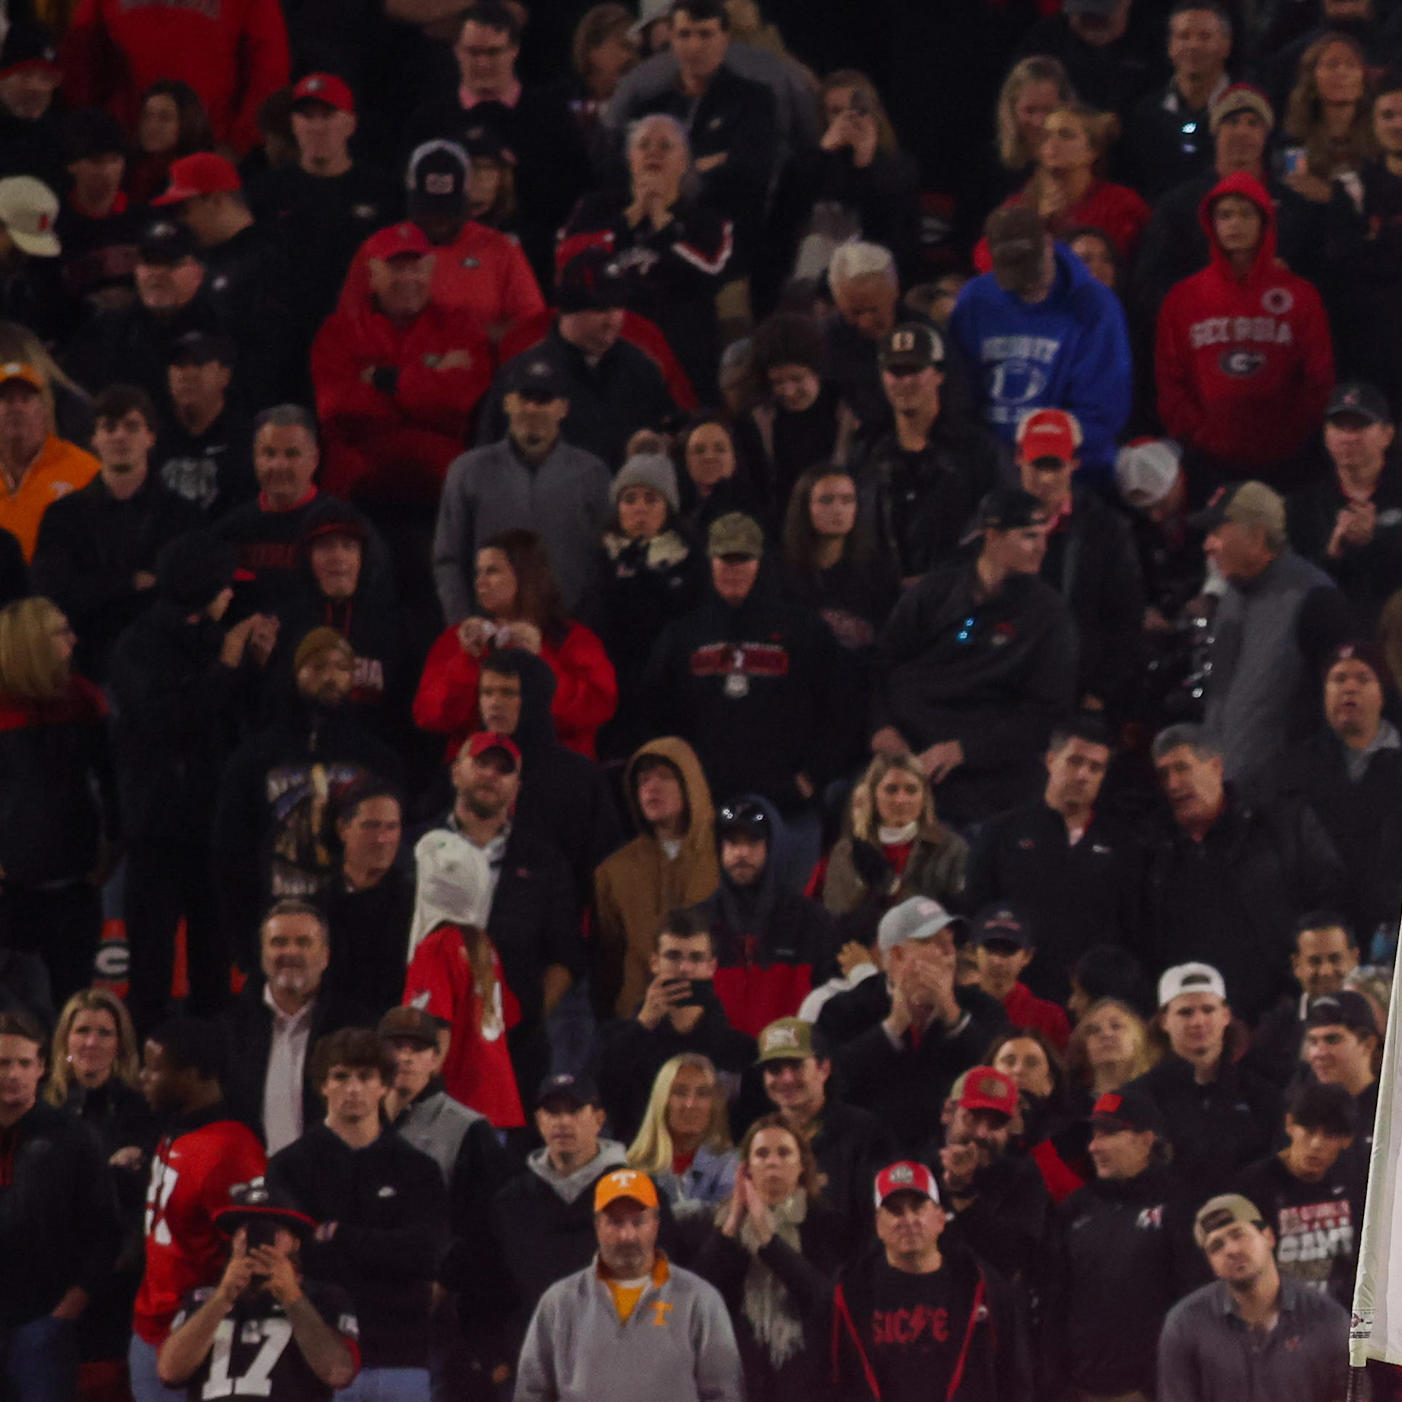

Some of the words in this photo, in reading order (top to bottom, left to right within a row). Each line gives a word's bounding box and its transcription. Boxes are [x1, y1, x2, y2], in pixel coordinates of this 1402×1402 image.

[611, 1171, 637, 1188] T
[650, 1301, 673, 1326] T
[201, 1317, 293, 1401] 17
